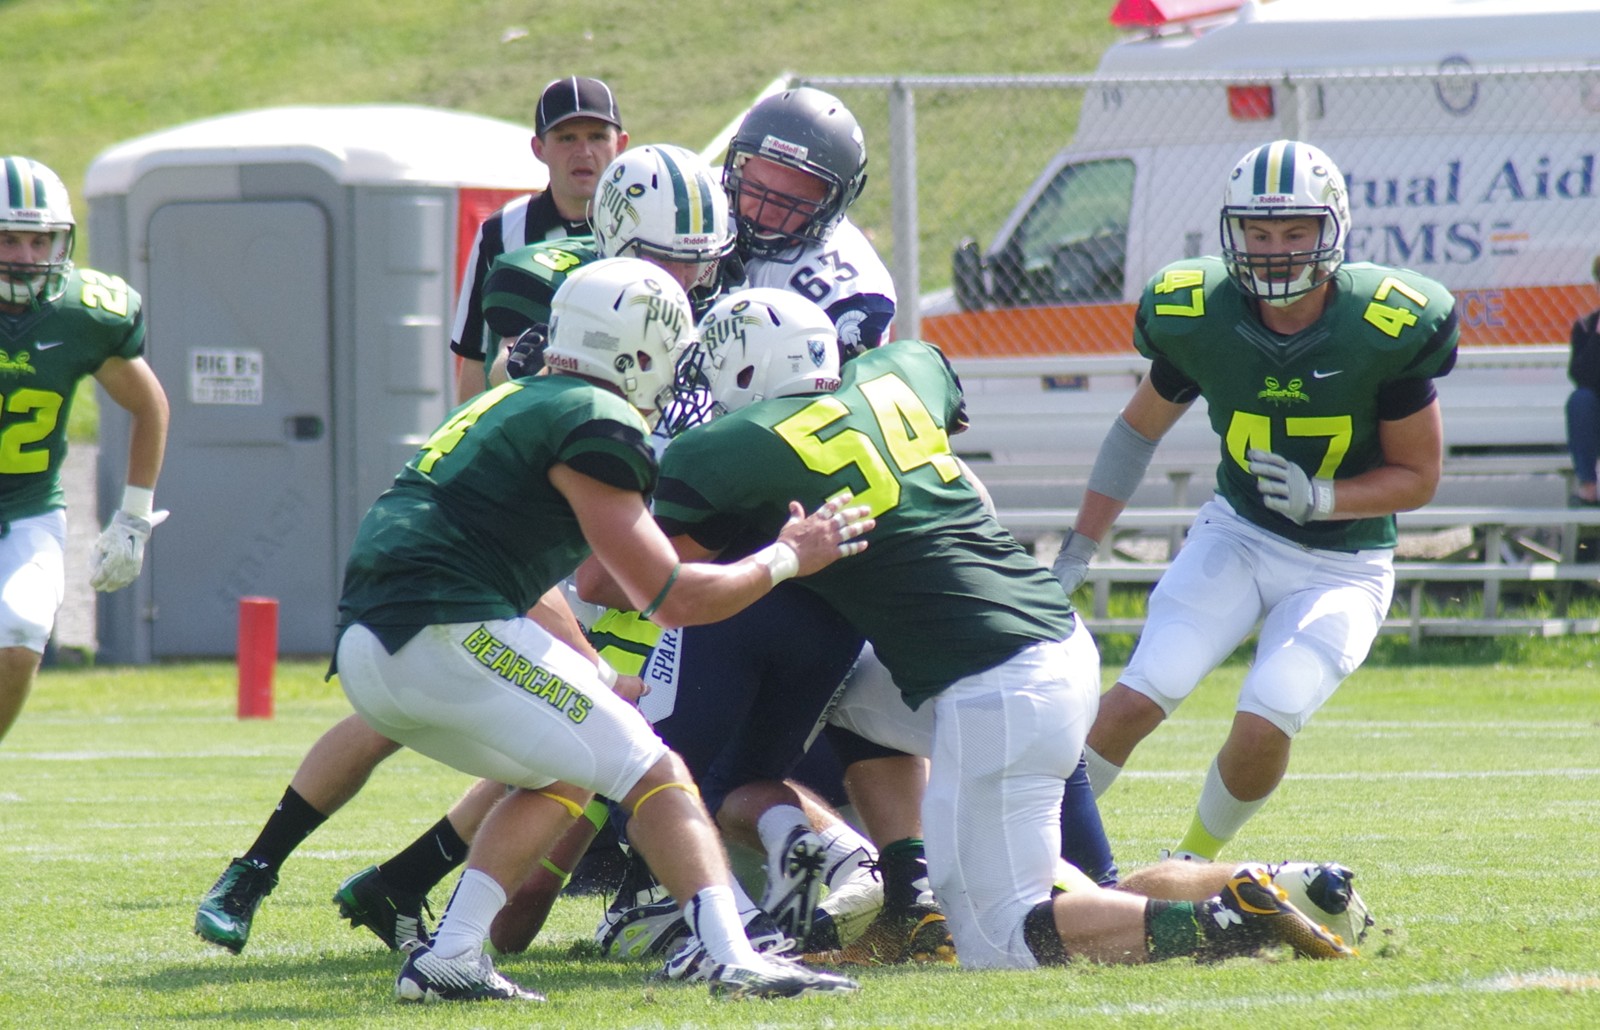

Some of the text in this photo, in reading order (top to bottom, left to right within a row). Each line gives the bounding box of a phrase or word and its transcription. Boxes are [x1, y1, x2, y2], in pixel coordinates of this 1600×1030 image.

[772, 139, 799, 155] Riddell
[1258, 196, 1287, 204] Riddell
[1344, 158, 1463, 210] tual
[1483, 153, 1596, 202] Aid
[532, 247, 582, 276] 3
[683, 236, 709, 245] Riddell
[1344, 219, 1482, 265] EMS
[80, 267, 129, 318] 22
[790, 249, 859, 304] 63
[1153, 269, 1206, 318] 47
[1363, 276, 1430, 340] 47
[1461, 289, 1505, 329] CE
[548, 353, 579, 371] ddell
[0, 388, 64, 474] 2
[416, 381, 525, 474] 4
[772, 372, 962, 518] 54
[1226, 410, 1353, 481] 47
[461, 623, 594, 725] BEARCATS
[651, 628, 679, 685] SPAR
